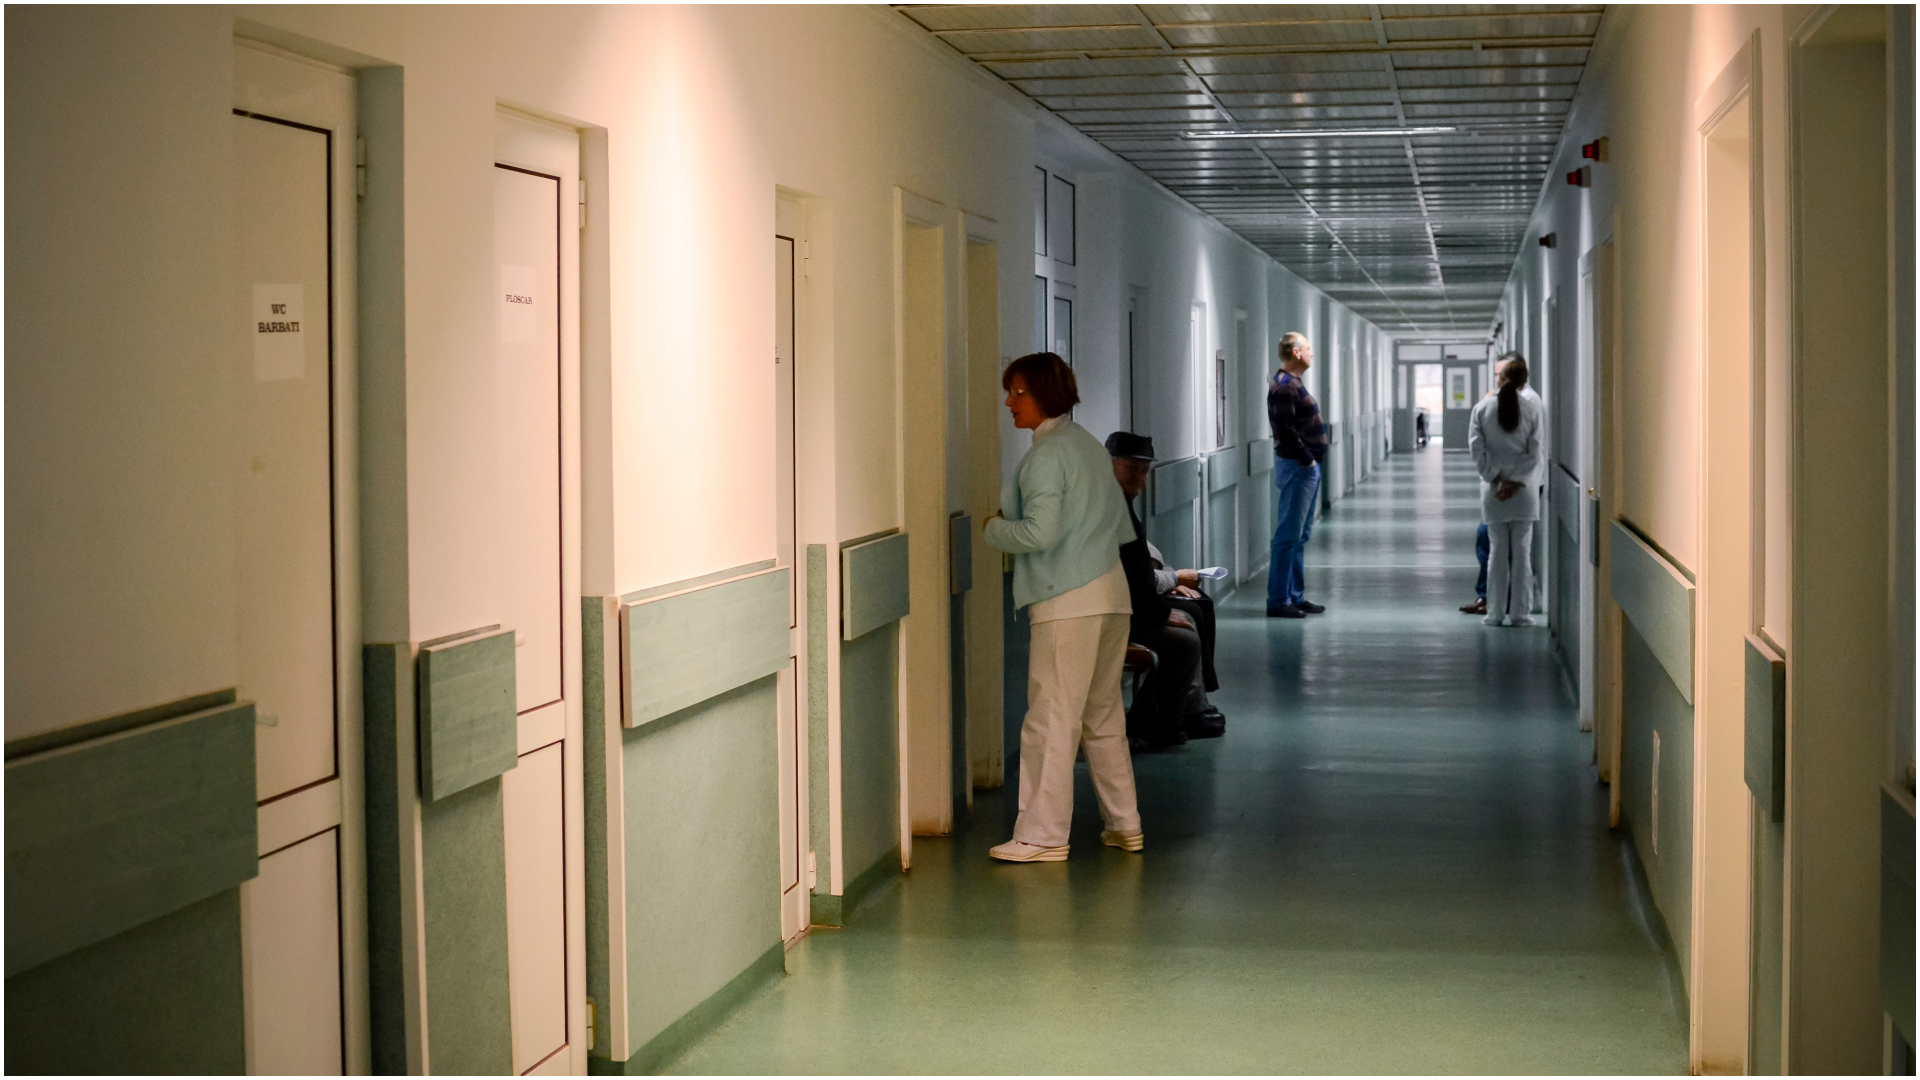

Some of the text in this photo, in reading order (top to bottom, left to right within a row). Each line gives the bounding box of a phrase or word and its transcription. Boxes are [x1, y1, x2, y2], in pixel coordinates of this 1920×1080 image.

[506, 294, 533, 305] PLOSCAR
[271, 303, 286, 315] WC
[258, 321, 300, 333] BARBATI
